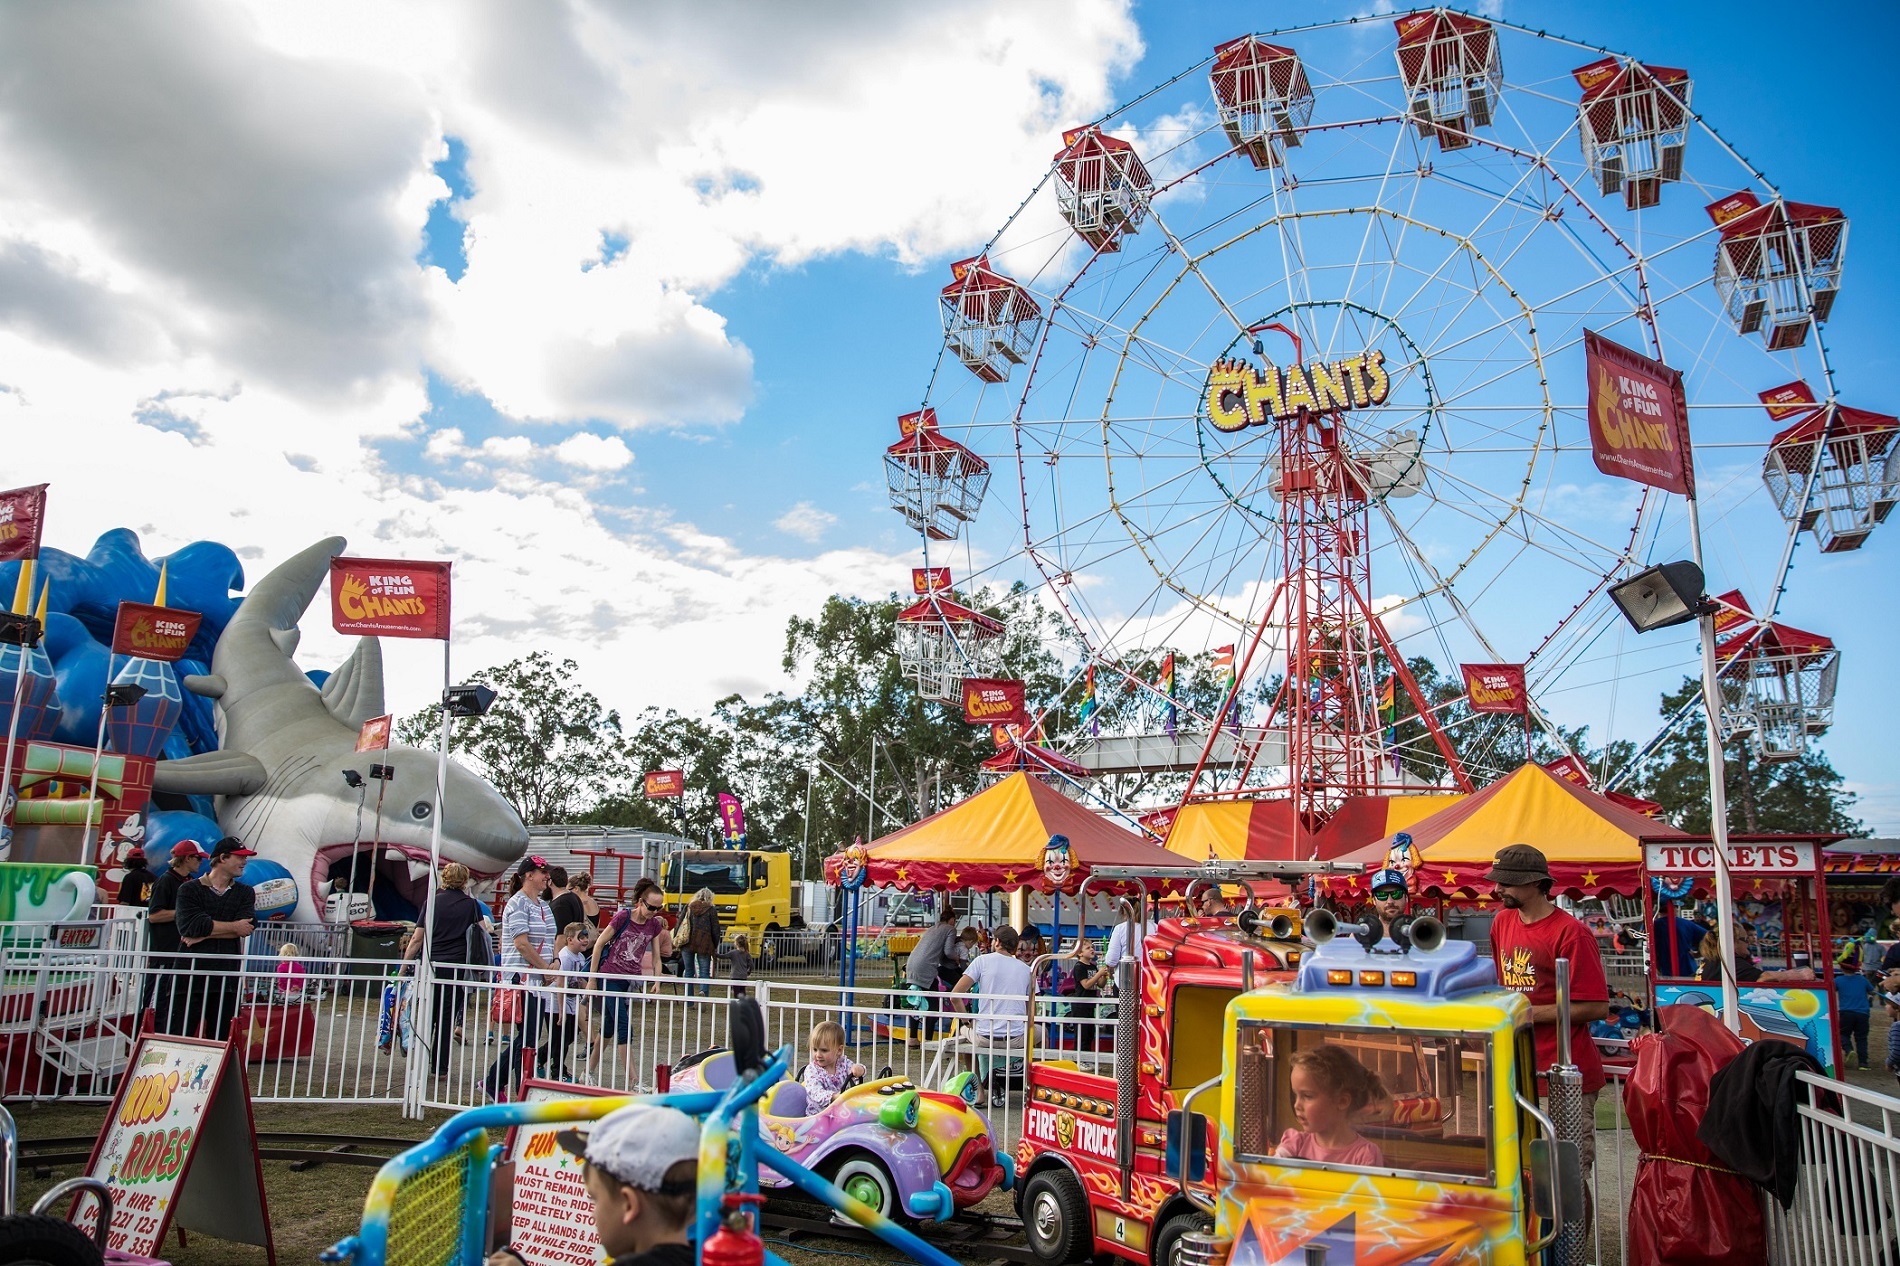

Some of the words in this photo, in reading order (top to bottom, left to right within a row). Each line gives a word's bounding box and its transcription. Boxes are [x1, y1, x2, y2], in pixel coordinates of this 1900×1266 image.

[1206, 349, 1390, 433] CHANTS
[1618, 375, 1658, 400] KING
[1597, 381, 1674, 452] CHANTS
[1623, 397, 1633, 409] OF
[1634, 397, 1662, 417] FUN
[369, 575, 413, 586] KING
[384, 585, 415, 595] FUN
[339, 583, 426, 620] CHANTS
[156, 620, 186, 630] KING
[164, 628, 186, 637] FUN
[131, 623, 188, 649] CHANTS
[1483, 675, 1507, 684] KING
[1492, 682, 1509, 690] FUN
[982, 690, 1004, 698] KING
[1470, 681, 1516, 704] CHANTS
[968, 696, 1013, 717] CHANTS
[60, 928, 96, 946] ENTRY
[119, 1070, 180, 1127] KIDS
[1028, 1108, 1056, 1141] FIRE
[1076, 1118, 1117, 1159] TRUCK
[118, 1126, 193, 1186] RIDES
[523, 1130, 560, 1161] FUN
[525, 1165, 549, 1178] ALL
[554, 1170, 585, 1185] CHIL
[514, 1175, 543, 1189] MUST
[544, 1181, 585, 1198] REMAIN
[126, 1191, 157, 1212] HIRE
[519, 1188, 547, 1203] UNTIL
[551, 1195, 568, 1208] the
[570, 1199, 596, 1213] RIDE
[513, 1200, 573, 1221] OMPLETELY
[574, 1213, 597, 1226] STO
[134, 1215, 158, 1234] 125
[531, 1220, 546, 1233] ALL
[548, 1223, 578, 1240] HANDS
[579, 1230, 586, 1241] &
[1116, 1222, 1124, 1238] 4
[128, 1236, 154, 1256] 353
[518, 1231, 532, 1241] IN
[532, 1234, 568, 1250] WHILE
[567, 1242, 596, 1256] RIDE
[525, 1245, 542, 1256] IN
[541, 1249, 598, 1266] MOTION
